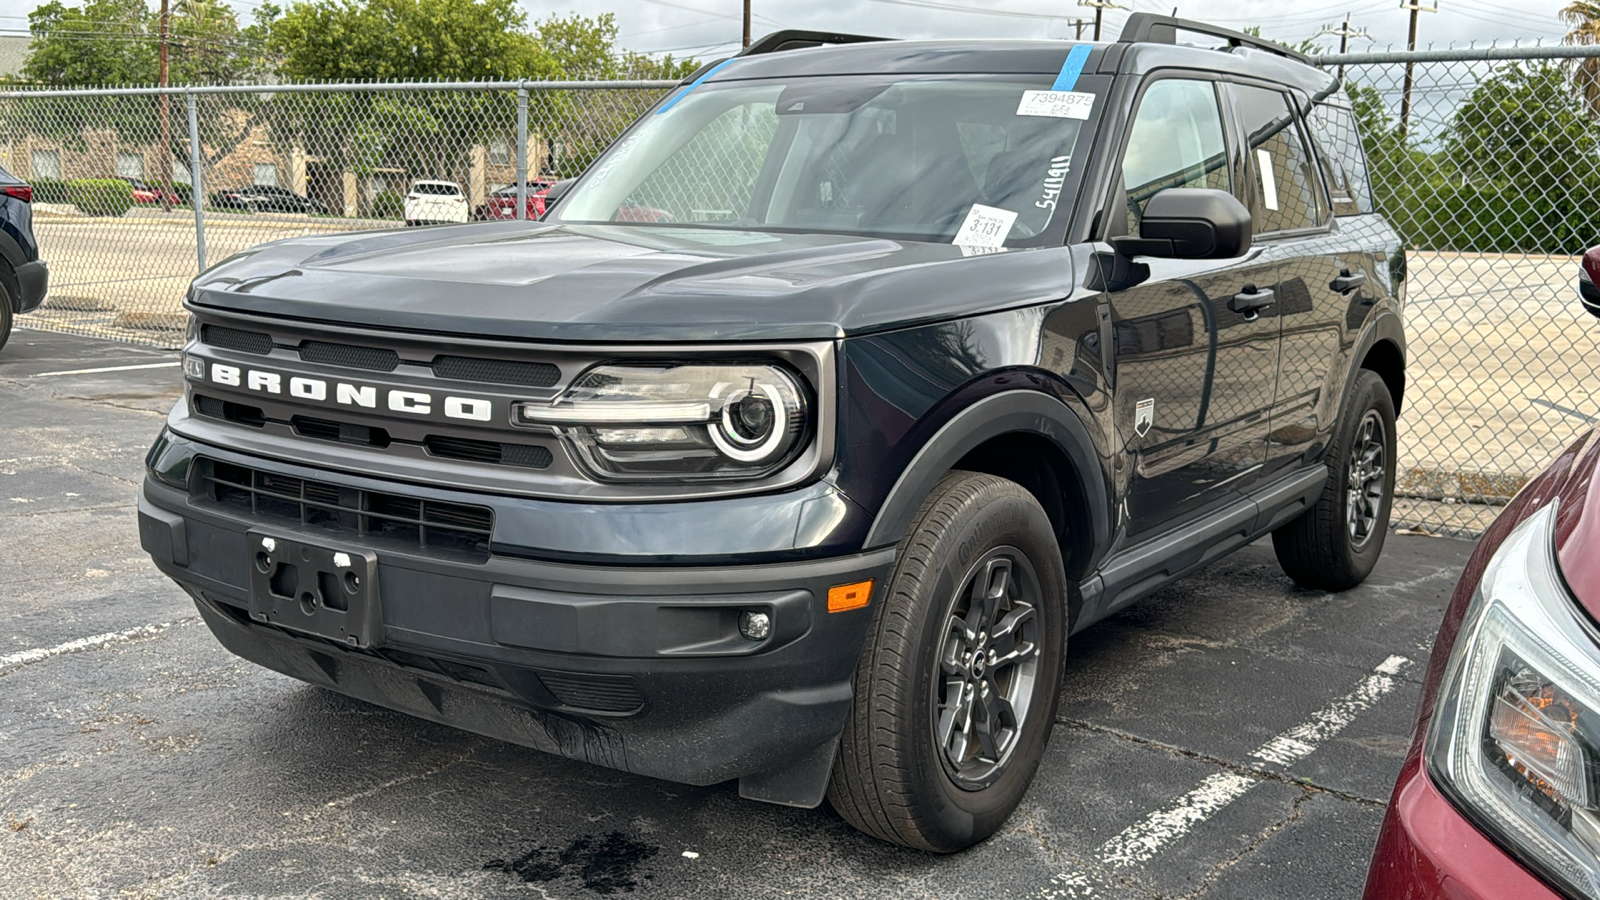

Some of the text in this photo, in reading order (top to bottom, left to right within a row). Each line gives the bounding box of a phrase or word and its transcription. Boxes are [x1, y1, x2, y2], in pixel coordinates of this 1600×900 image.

[1031, 93, 1093, 107] 7394875
[970, 219, 1002, 237] 3:131
[211, 363, 492, 421] BRONCO
